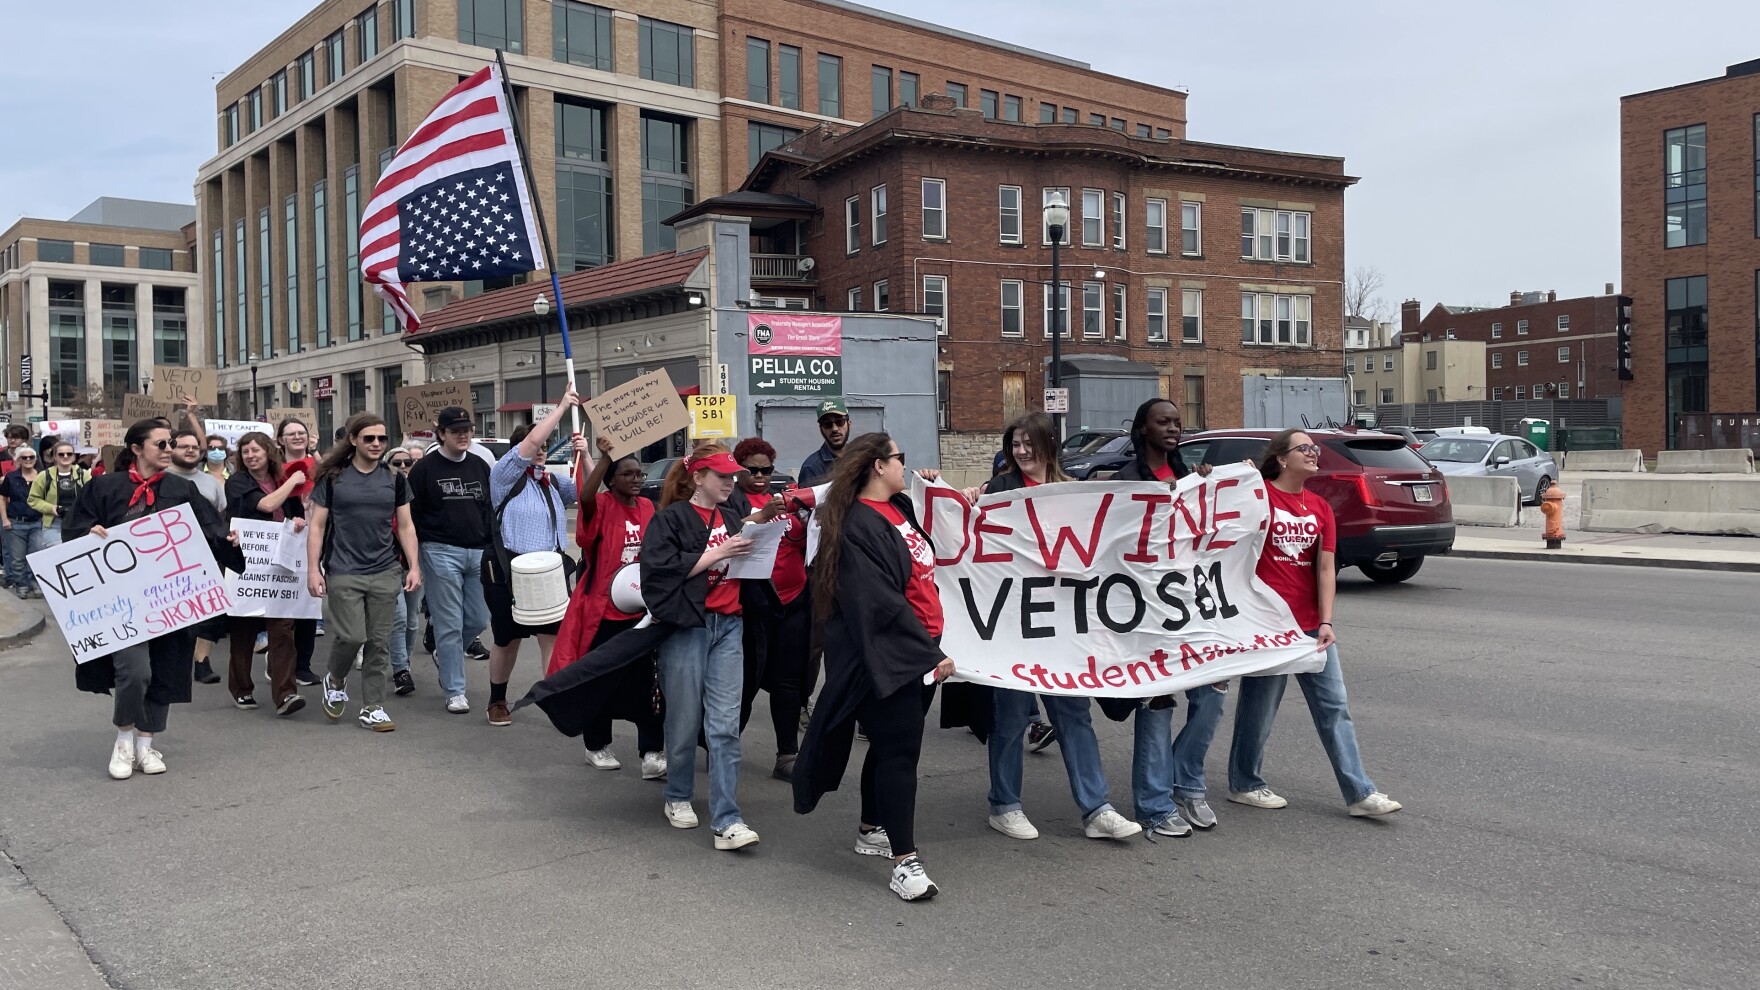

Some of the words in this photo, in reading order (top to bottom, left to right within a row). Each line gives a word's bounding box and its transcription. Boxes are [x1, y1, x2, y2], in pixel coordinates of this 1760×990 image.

[752, 358, 806, 374] PELLA
[810, 359, 838, 375] CO.
[162, 368, 202, 383] VETO
[614, 392, 630, 404] more
[631, 386, 644, 396] you
[406, 410, 424, 420] RIP
[614, 400, 638, 416] silence
[702, 410, 723, 418] SB1
[602, 422, 622, 436] THE
[622, 406, 654, 428] LOUDER
[655, 398, 670, 408] WE
[208, 422, 232, 432] THEY
[620, 428, 646, 442] WILL
[646, 413, 664, 428] BE!
[243, 530, 265, 540] WE'VE
[266, 532, 279, 540] SEE
[1272, 522, 1320, 536] OHIO
[36, 539, 138, 599] VETO
[244, 557, 270, 566] TALIAN
[144, 574, 193, 598] equity
[238, 574, 270, 582] AGAINST
[237, 587, 278, 598] SCREW
[280, 590, 299, 600] SB1!
[958, 572, 1146, 640] VETO
[71, 632, 108, 656] MAKE
[112, 621, 138, 642] US
[1012, 656, 1172, 690] Student
